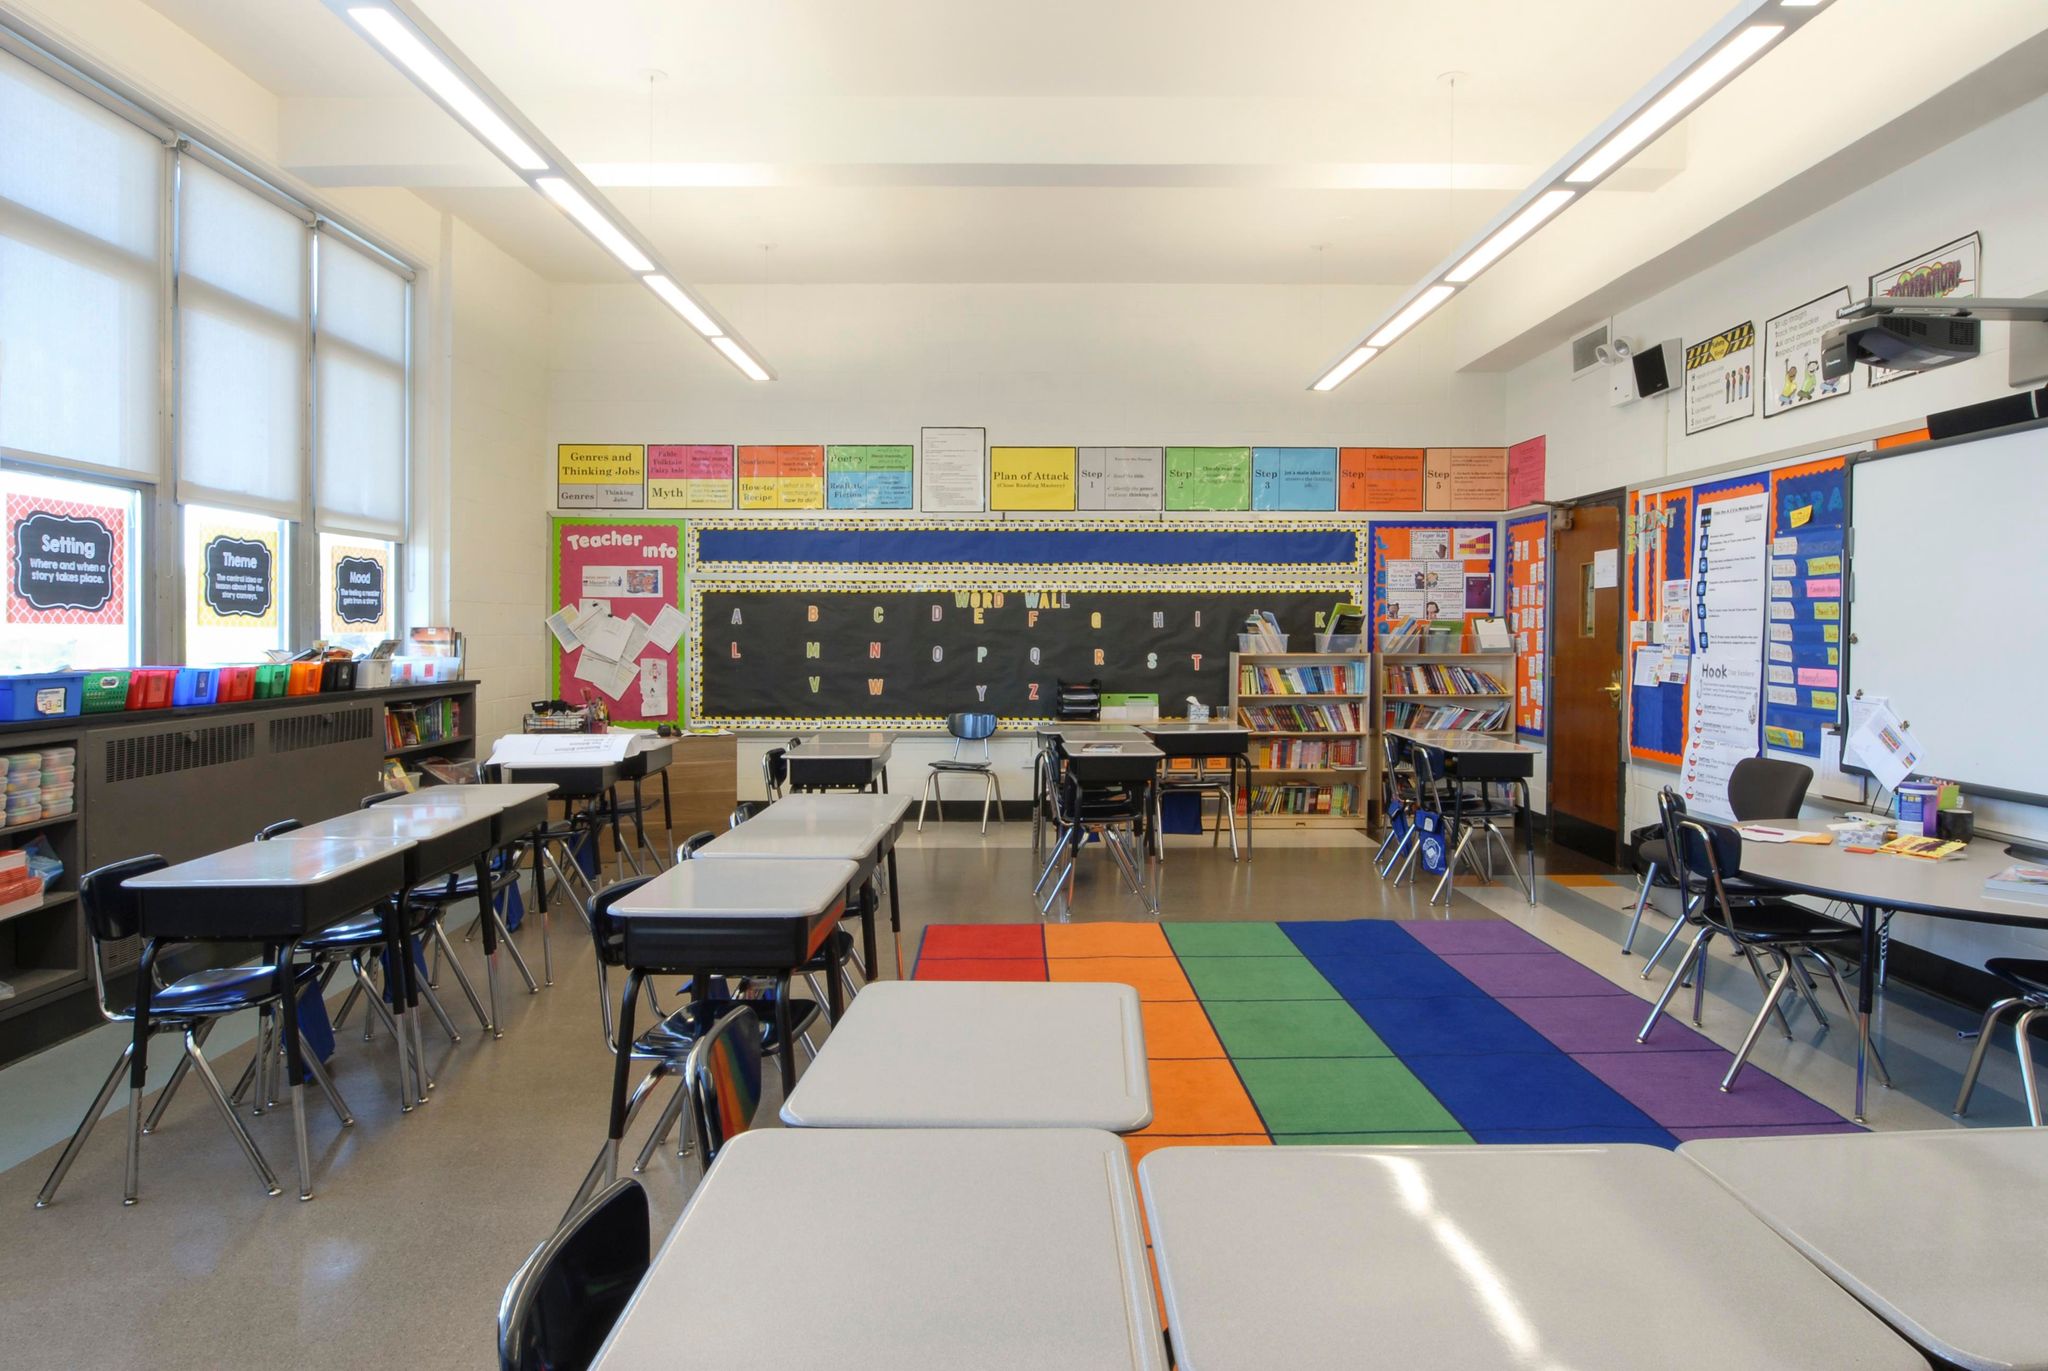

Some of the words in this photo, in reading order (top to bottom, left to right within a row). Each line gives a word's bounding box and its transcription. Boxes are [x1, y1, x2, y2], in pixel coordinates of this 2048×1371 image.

[570, 452, 609, 462] Genres
[611, 452, 632, 462] and
[828, 454, 864, 464] Poetry
[562, 466, 612, 477] Thinking
[614, 466, 641, 476] Jobs
[993, 471, 1017, 481] Plan
[1020, 471, 1031, 481] of
[1033, 471, 1070, 481] Attack
[1081, 469, 1103, 479] Step
[1169, 470, 1193, 479] Step
[1255, 469, 1278, 479] Step
[1342, 469, 1364, 479] Step
[1427, 470, 1450, 479] Step
[1264, 481, 1271, 489] 3
[1436, 481, 1442, 490] 5
[561, 492, 595, 501] Genres
[652, 487, 683, 498] Myth
[833, 491, 863, 499] Fiction
[743, 494, 773, 503] Recipe
[567, 530, 643, 551] Teacher
[41, 534, 96, 559] Setting
[222, 551, 258, 569] Theme
[30, 558, 58, 570] Where
[59, 561, 75, 571] and
[76, 563, 99, 572] when
[99, 565, 106, 573] a
[31, 571, 55, 583] story
[55, 572, 79, 583] takes
[79, 573, 105, 585] place.
[349, 571, 371, 585] Mood
[222, 592, 235, 601] story
[954, 591, 1005, 609] WORD
[1024, 592, 1071, 610] WALL
[731, 608, 742, 625] A
[807, 605, 819, 622] B
[873, 606, 884, 624] C
[931, 604, 943, 622] D
[973, 607, 985, 625] E
[1028, 611, 1039, 628] F
[1153, 611, 1164, 628] H
[1194, 611, 1201, 628] I
[1314, 611, 1326, 628] K
[731, 641, 742, 659] L
[806, 641, 821, 659] M
[869, 641, 881, 659] N
[932, 645, 944, 663] O
[977, 646, 988, 663] P
[1029, 647, 1041, 666] Q
[1094, 648, 1105, 666] R
[1146, 652, 1158, 669] S
[1191, 654, 1202, 671] T
[1702, 663, 1727, 679] Hook
[808, 676, 821, 693] V
[868, 678, 884, 696] W
[975, 685, 988, 702] Y
[1028, 683, 1039, 701] Z
